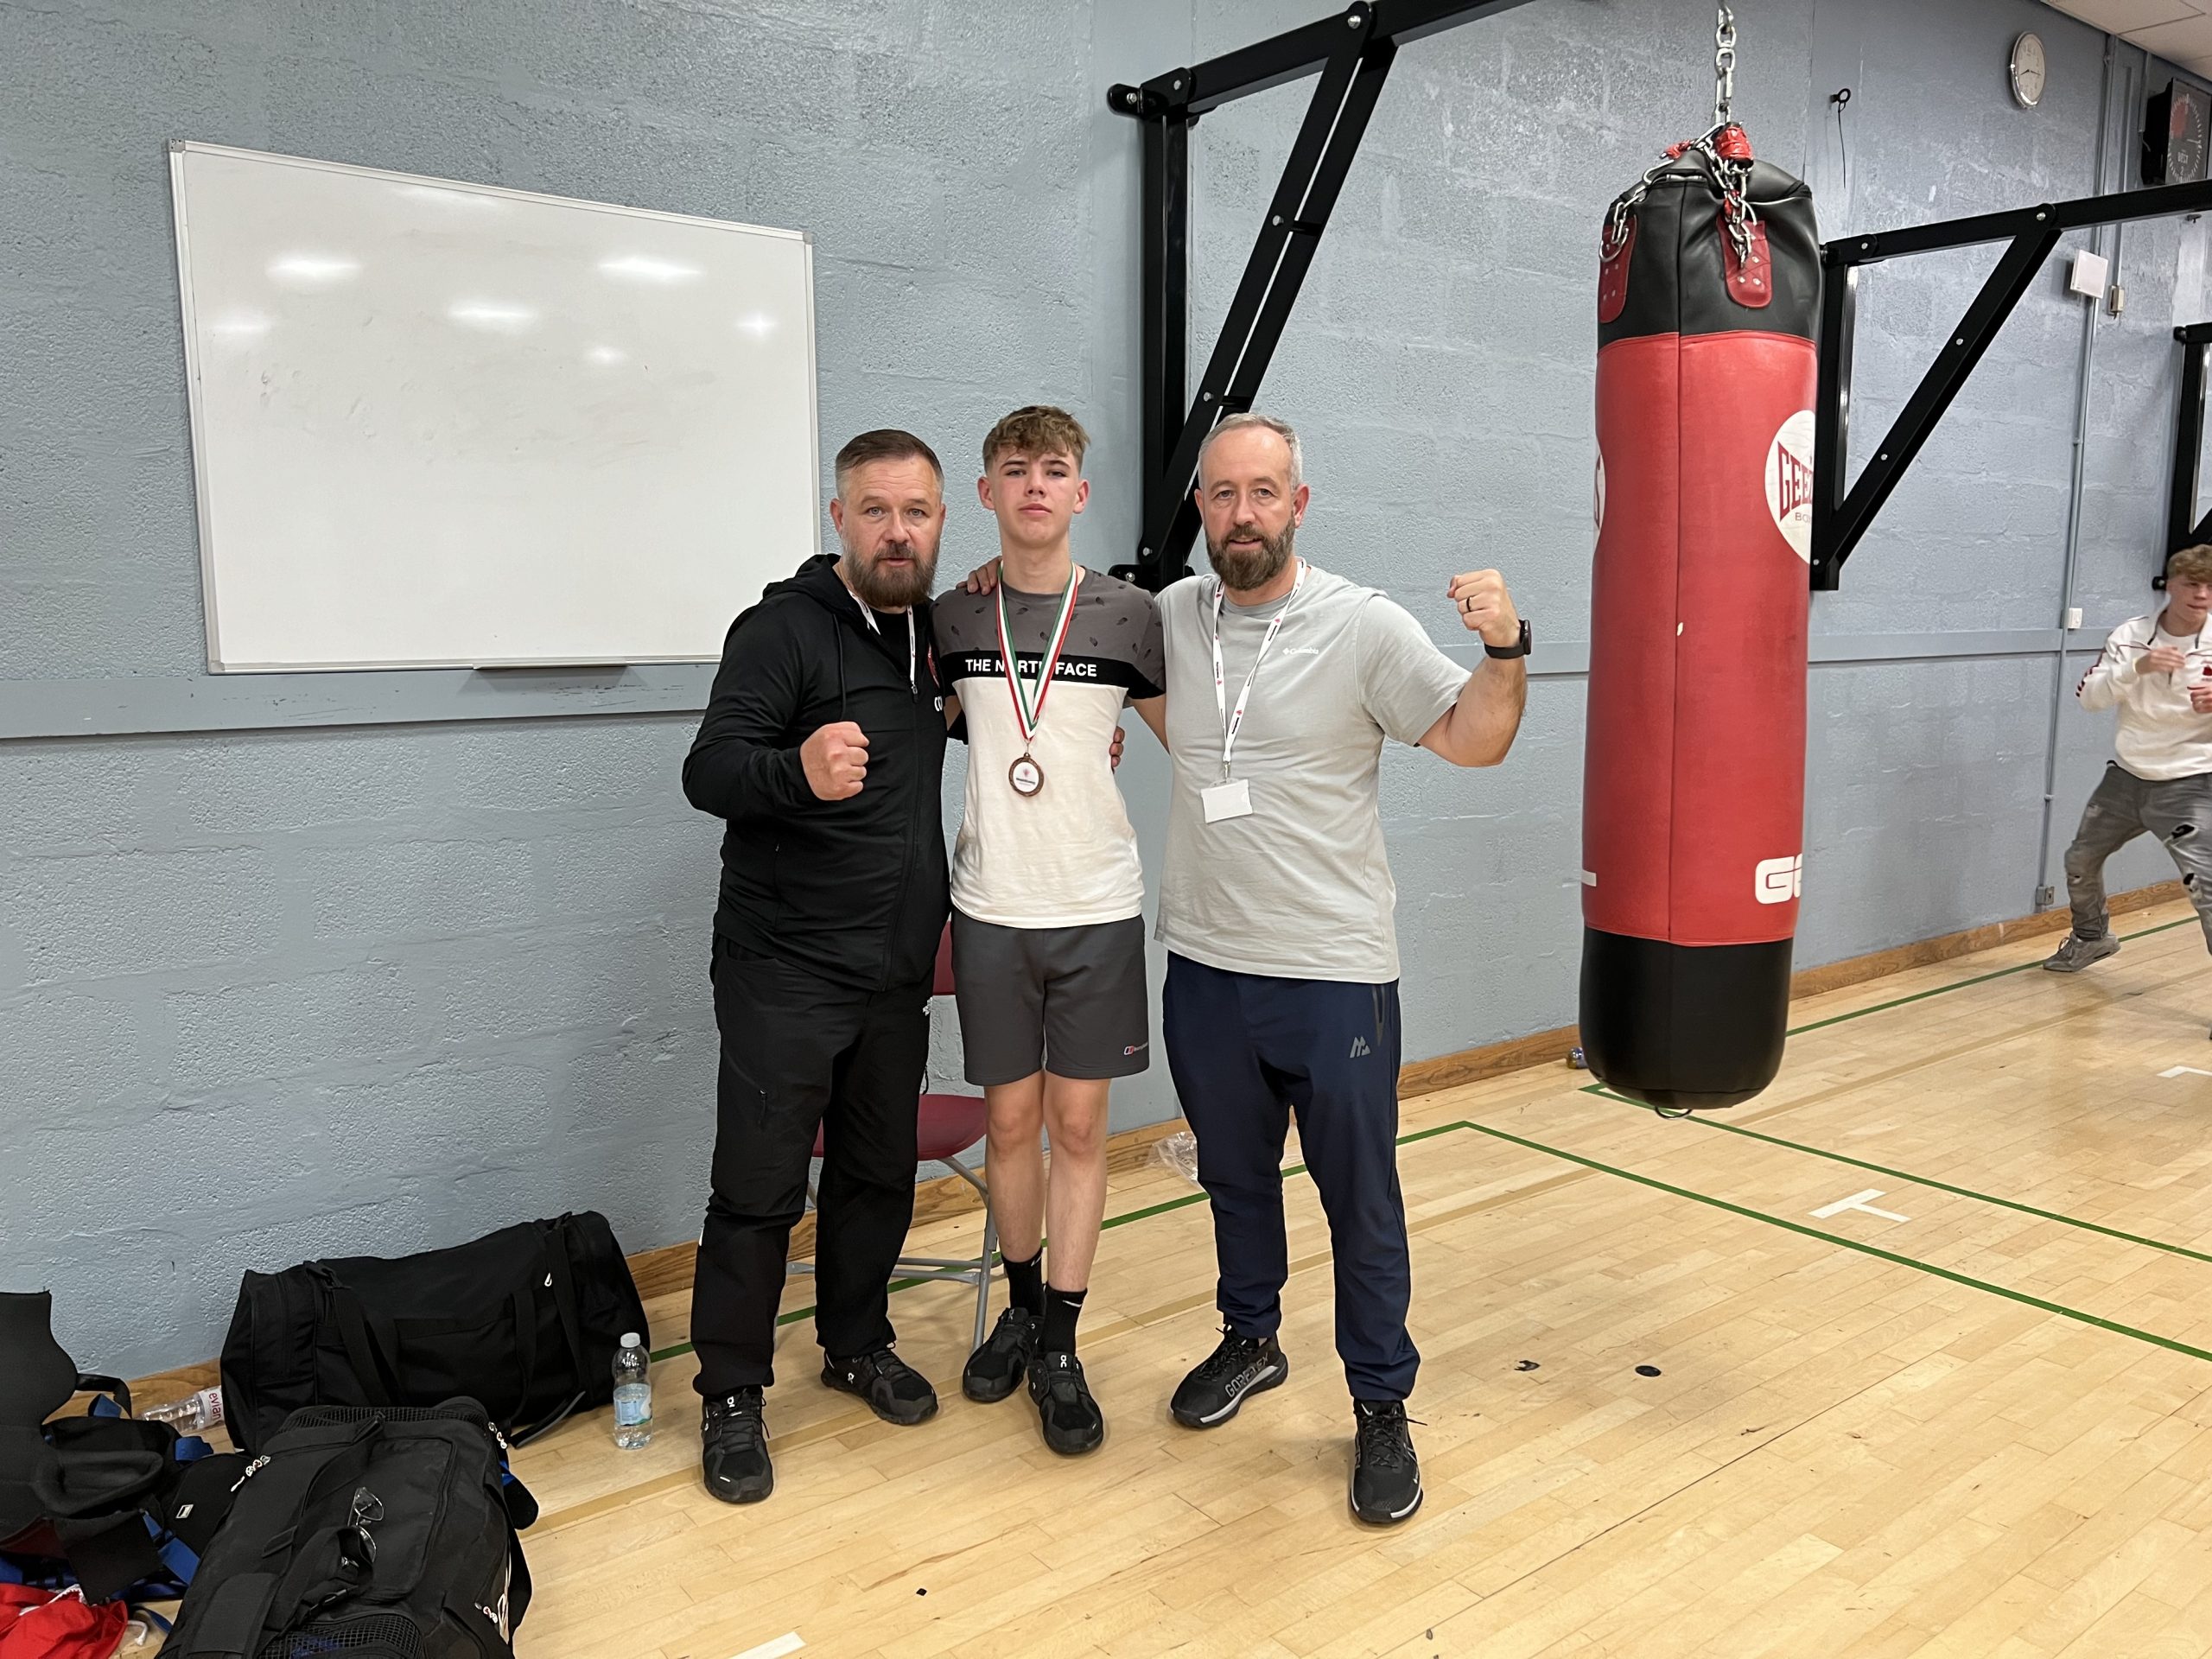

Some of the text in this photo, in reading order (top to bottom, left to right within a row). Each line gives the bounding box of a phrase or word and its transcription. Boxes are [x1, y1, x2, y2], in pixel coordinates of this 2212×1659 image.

[965, 659, 1097, 677] THE NRT FACE
[208, 1392, 222, 1421] evian
